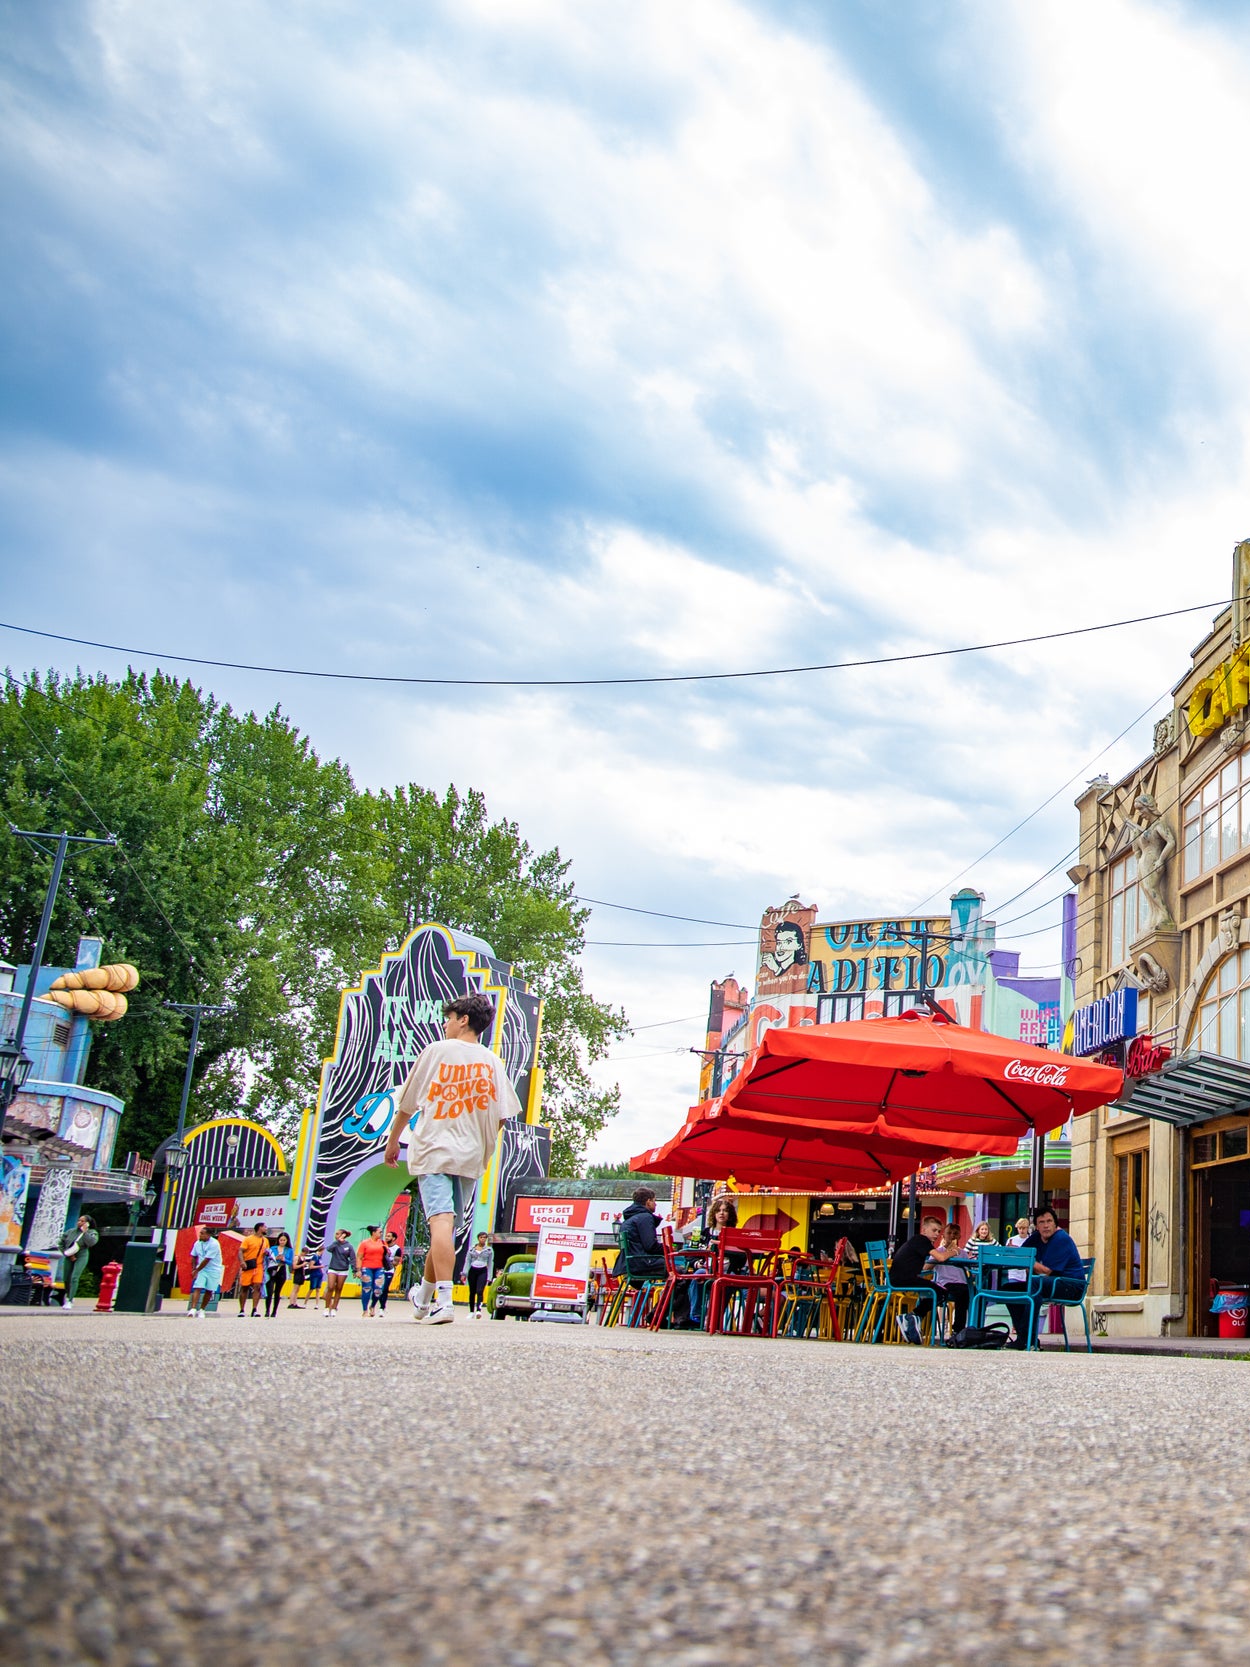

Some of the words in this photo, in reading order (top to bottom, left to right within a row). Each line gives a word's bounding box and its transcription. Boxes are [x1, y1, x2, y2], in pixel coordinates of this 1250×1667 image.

[807, 954, 947, 994] ADITIO
[383, 995, 408, 1024] IT
[414, 999, 449, 1024] WA
[1020, 1007, 1059, 1020] WHAT
[1073, 988, 1125, 1056] AMERICAN
[1020, 1022, 1047, 1034] ARE
[372, 1030, 418, 1062] ALL
[1126, 1035, 1162, 1079] Bar
[1004, 1059, 1070, 1086] Coca-Cola
[554, 1251, 575, 1273] P
[1232, 1319, 1246, 1327] OLA
